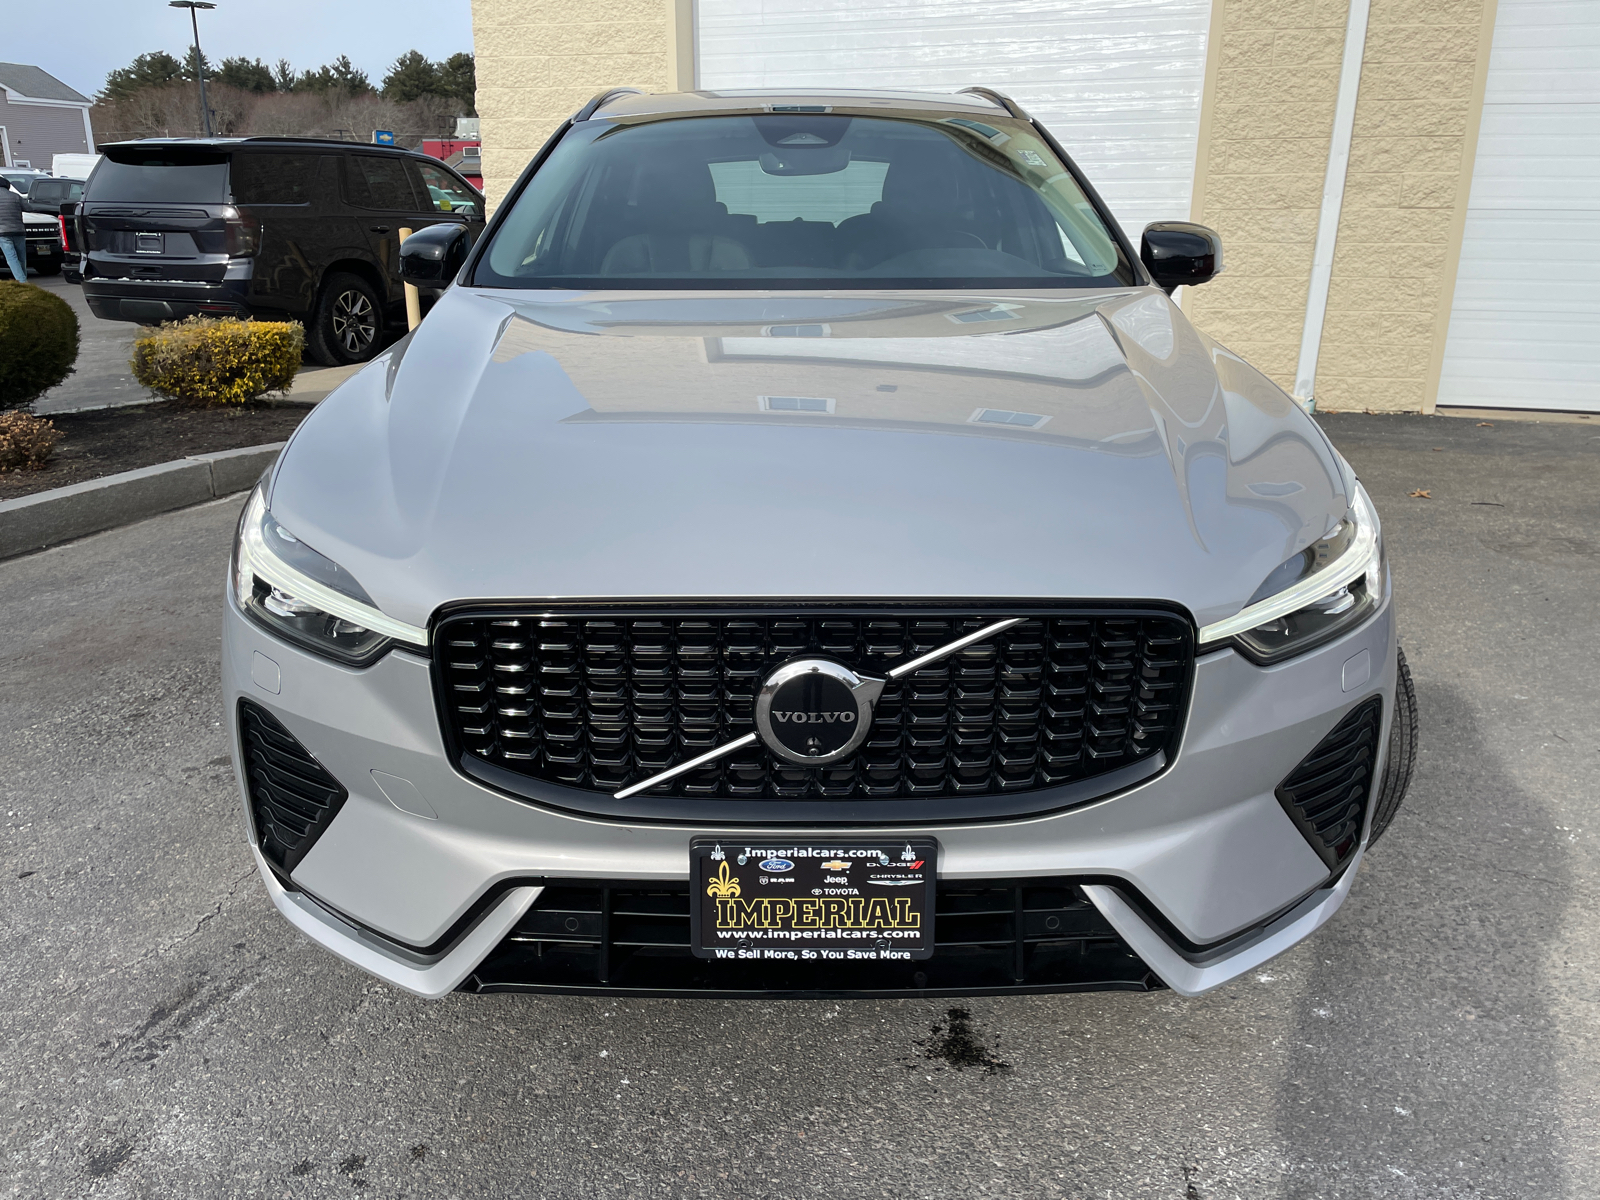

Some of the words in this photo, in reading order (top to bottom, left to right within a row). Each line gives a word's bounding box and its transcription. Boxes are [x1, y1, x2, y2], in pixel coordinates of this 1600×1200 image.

[772, 711, 856, 723] VOLVO
[744, 847, 882, 859] Imperialcars.com
[824, 875, 848, 884] Jeep
[716, 898, 921, 928] IMPERIAL
[716, 929, 921, 940] www.imperialcars.com
[715, 950, 735, 959] We
[738, 950, 760, 959] Sell
[764, 950, 798, 960] More,
[801, 950, 817, 959] So
[821, 950, 844, 959] You
[847, 950, 876, 959] Save
[880, 950, 911, 959] More
